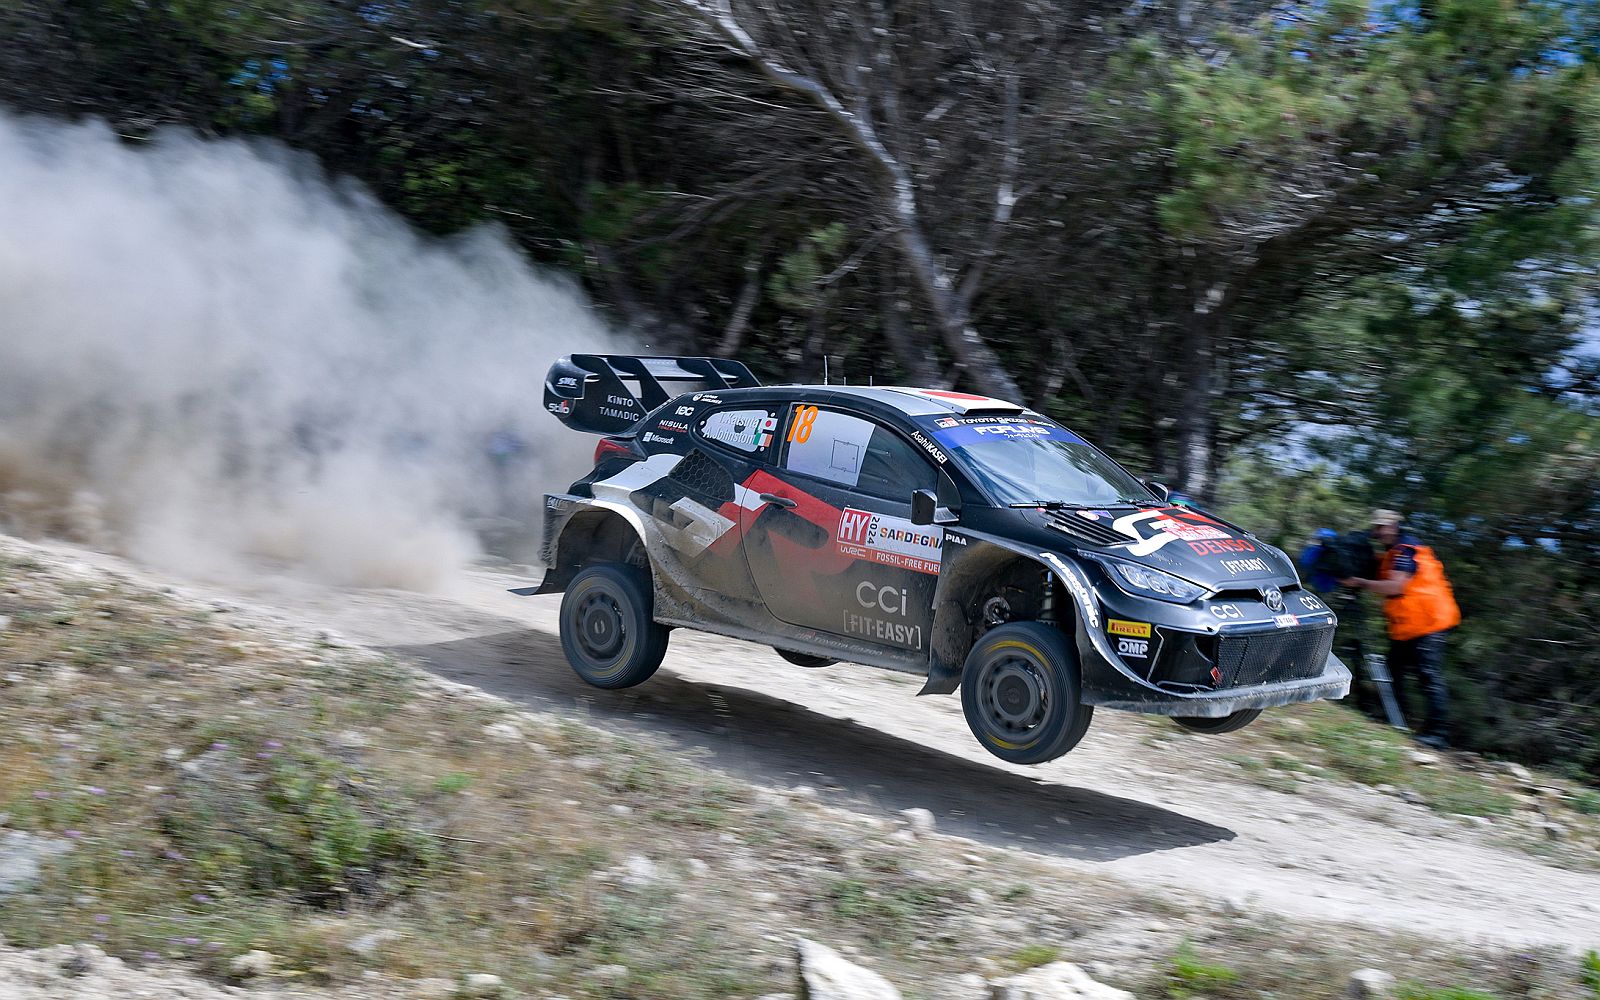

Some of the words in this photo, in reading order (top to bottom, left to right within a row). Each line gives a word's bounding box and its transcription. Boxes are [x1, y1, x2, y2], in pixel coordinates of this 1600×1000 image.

[599, 407, 640, 422] TAMADIC
[659, 420, 688, 430] NISULA
[786, 405, 819, 444] 18
[651, 434, 675, 445] Microsoft
[840, 511, 869, 543] HY
[867, 516, 880, 544] 2024
[945, 533, 967, 546] PIAA
[1187, 539, 1256, 556] DENSO
[876, 552, 922, 570] FOSSIL-FREE
[1111, 622, 1148, 635] PIRELLI
[1118, 643, 1148, 655] OMP
